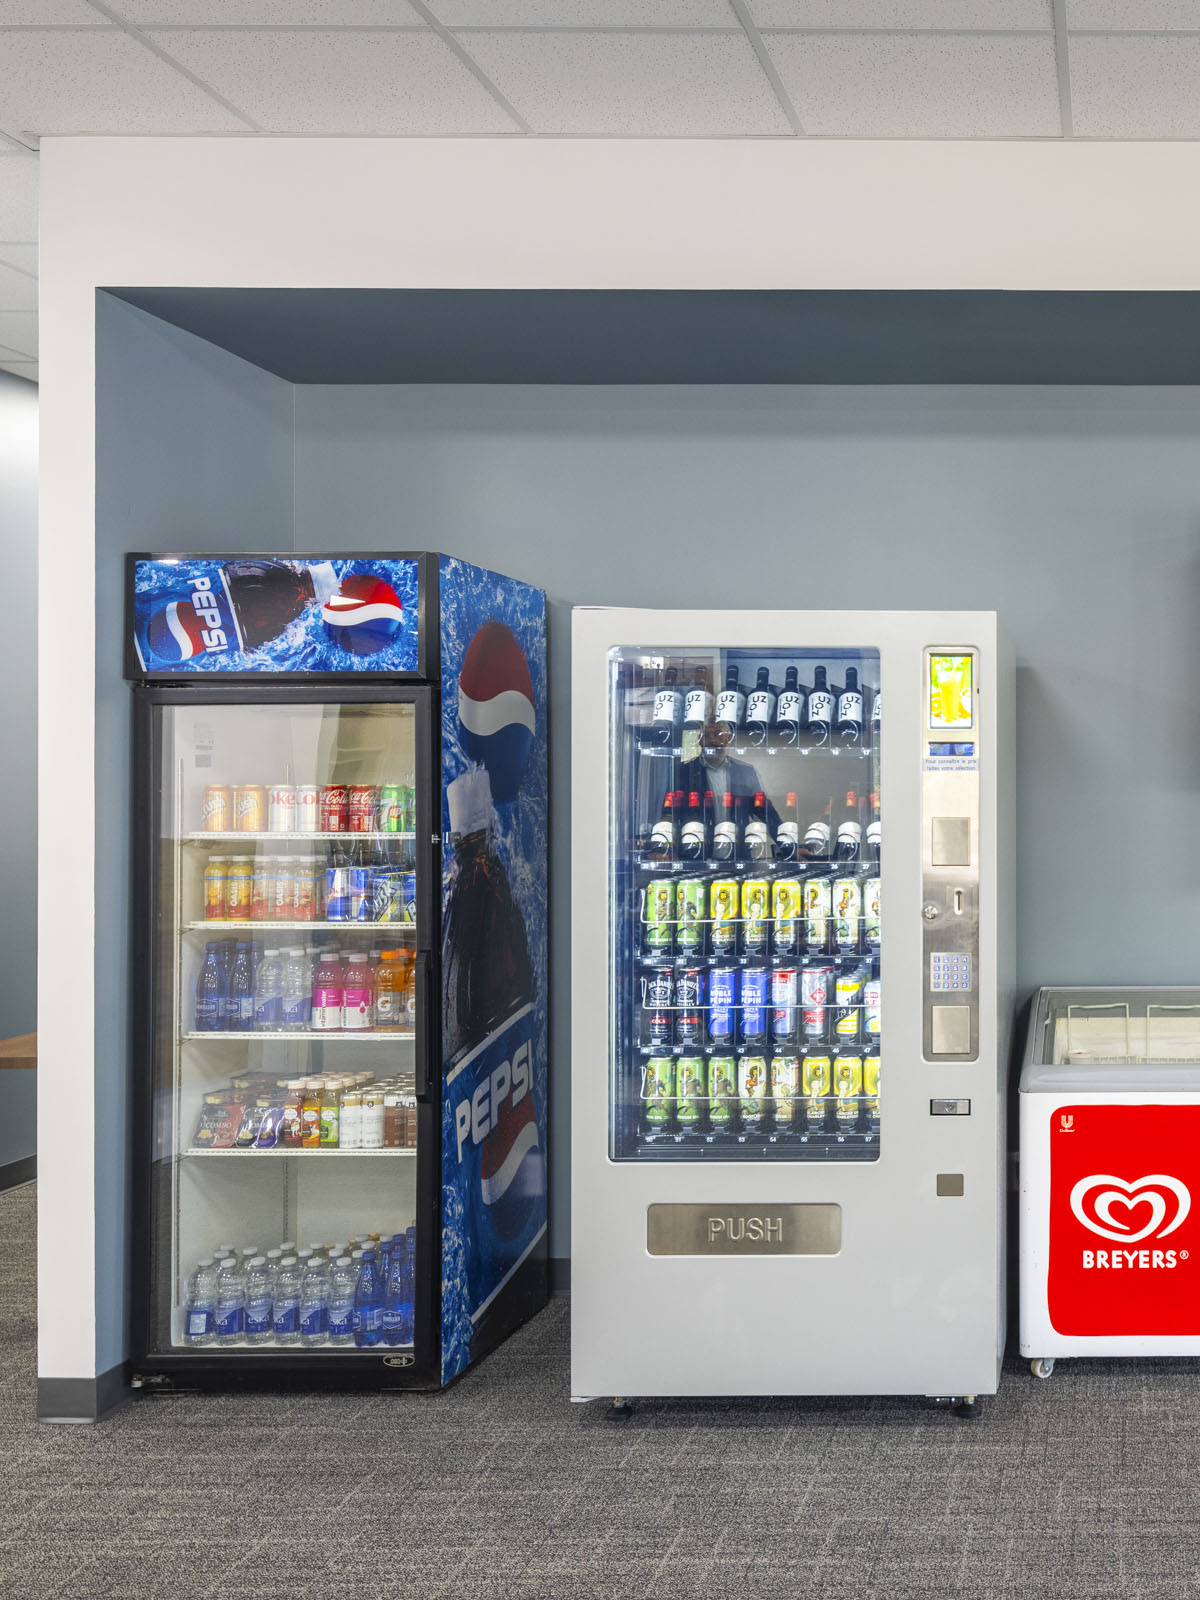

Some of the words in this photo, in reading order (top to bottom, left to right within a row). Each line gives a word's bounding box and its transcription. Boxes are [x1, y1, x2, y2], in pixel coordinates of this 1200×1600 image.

[186, 576, 231, 653] PEPSI
[455, 1039, 534, 1164] PEPSI
[708, 1217, 783, 1243] PUSH
